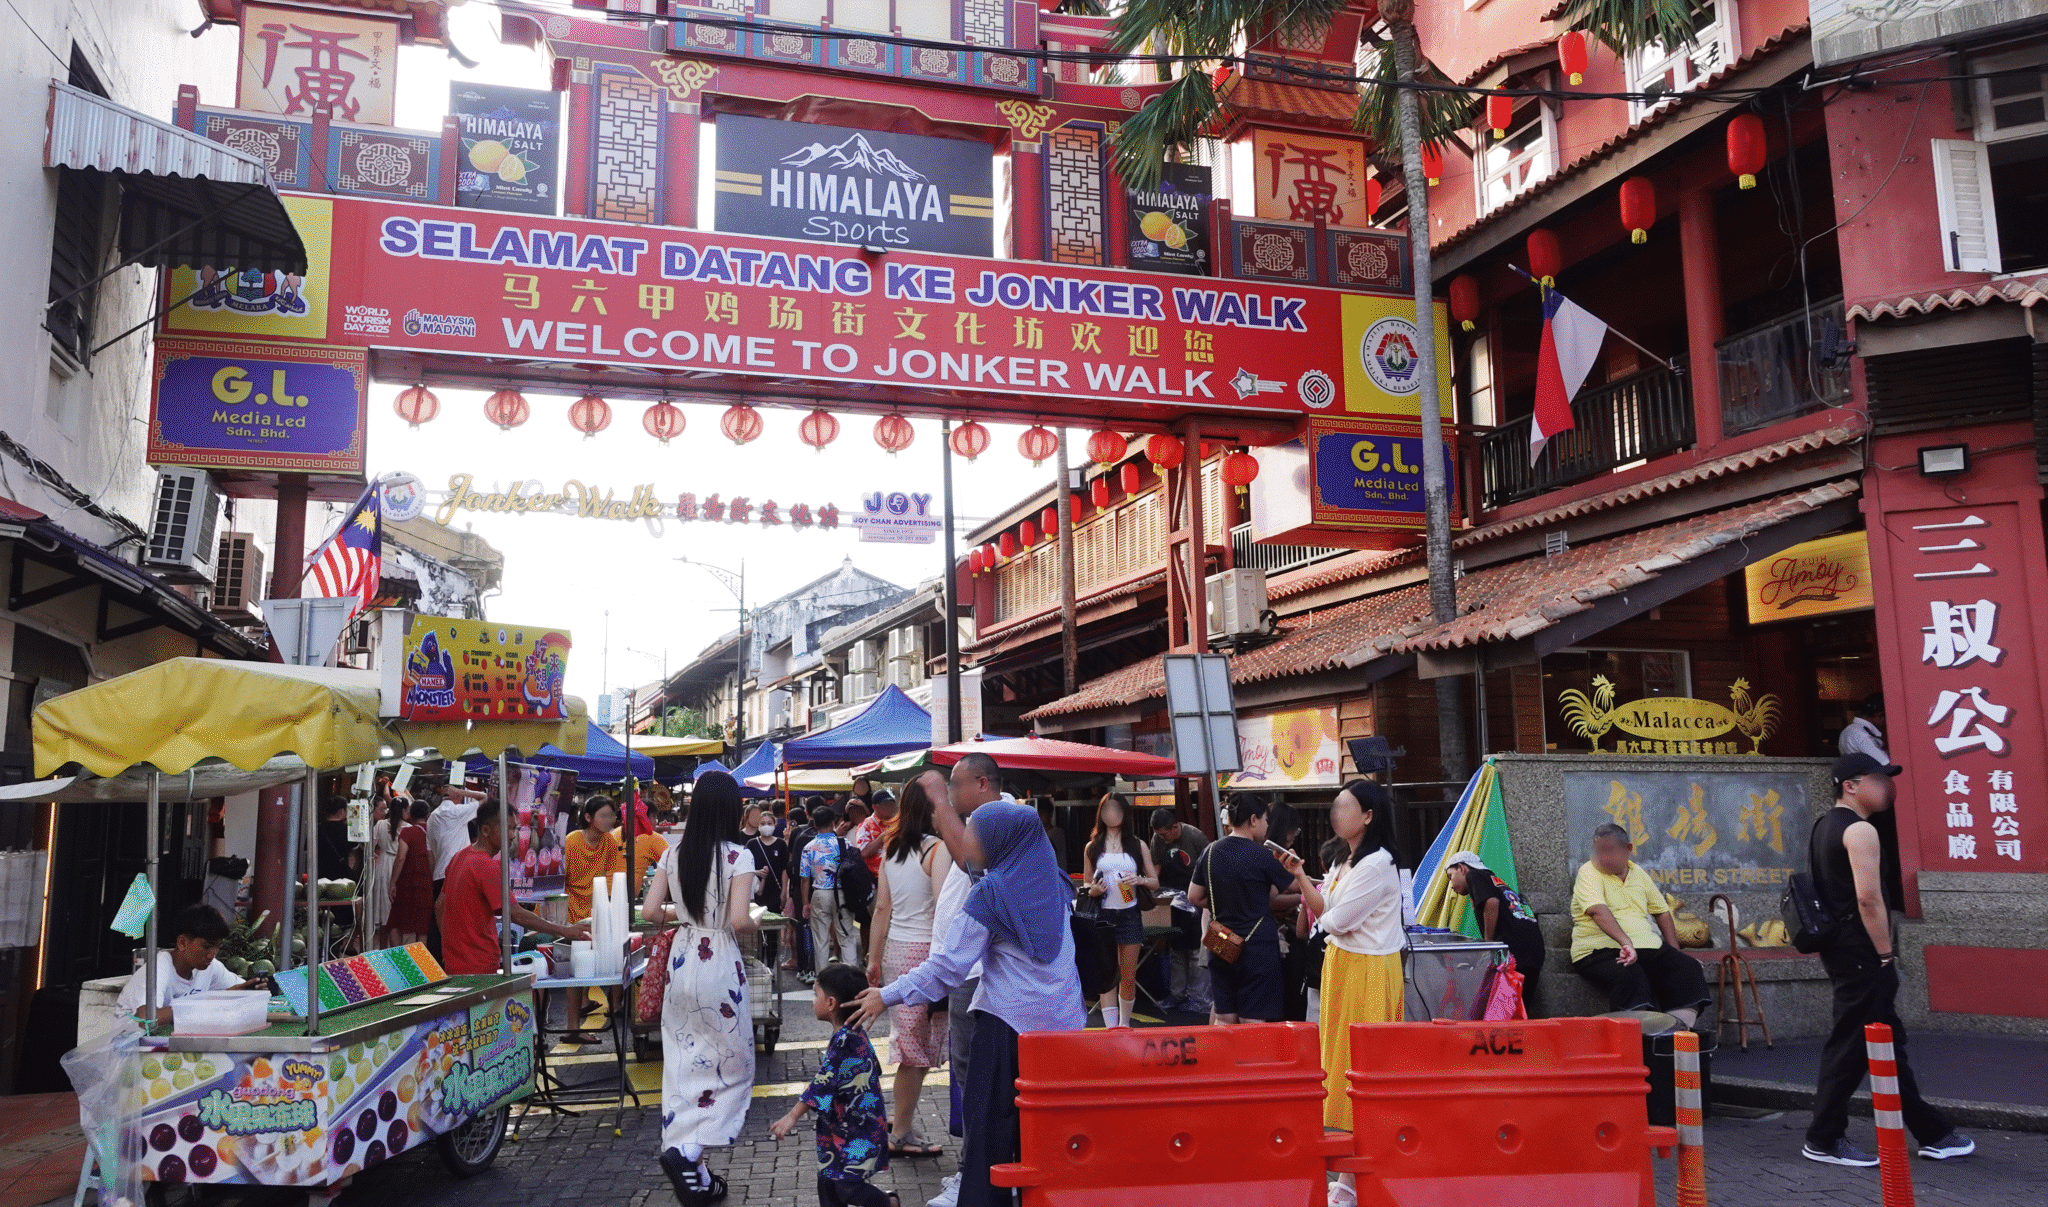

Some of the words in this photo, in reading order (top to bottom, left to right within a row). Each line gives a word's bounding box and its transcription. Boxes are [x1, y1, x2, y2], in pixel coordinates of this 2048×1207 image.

[466, 116, 543, 141] HIMALAYA
[514, 140, 543, 151] SALT
[771, 168, 944, 222] HIMALAYA
[1137, 190, 1199, 211] HIMALAYA
[1176, 211, 1199, 220] SALT
[802, 217, 910, 243] Sports
[380, 217, 648, 276] SELAMAT
[661, 242, 871, 296] DATANG
[885, 262, 954, 303] KE
[965, 272, 1166, 320] JONKER
[1173, 287, 1307, 332] WALK
[232, 302, 269, 310] MELAKA
[345, 305, 389, 316] WORLD
[343, 323, 365, 332] DAY
[366, 325, 389, 333] 2025
[345, 314, 391, 325] TOURISM
[423, 314, 475, 325] MALAYSIA
[503, 273, 1215, 363] 马六甲鸡场街文化坊欢迎您
[423, 323, 475, 336] MADANI
[502, 318, 776, 367] WELCOME
[792, 340, 858, 372] TO
[873, 347, 1070, 388] JONKER
[1083, 361, 1215, 398] WALK
[211, 366, 309, 408] G.L.
[212, 410, 271, 425] Media
[276, 415, 306, 428] Led
[226, 426, 255, 437] Sdn.
[260, 428, 290, 439] Bhd.
[1351, 440, 1419, 474] G.L.
[1354, 476, 1395, 490] Media
[1398, 480, 1419, 491] Led
[435, 473, 570, 526] Jonker
[563, 479, 664, 520] Walk
[864, 491, 931, 516] JOY
[1364, 491, 1386, 499] Sdn.
[1388, 492, 1410, 500] Bhd.
[893, 519, 942, 527] ADVERTISING
[1761, 557, 1859, 605] Amoy
[1912, 515, 2008, 753] 三叔公
[1632, 710, 1716, 729] Malacca
[1943, 770, 1978, 860] 食品廠
[1987, 770, 2021, 861] 有限公司
[1648, 868, 1708, 885] NKER
[1713, 867, 1796, 885] STREET
[1140, 1037, 1198, 1067] ACE
[1469, 1028, 1524, 1056] ACE
[233, 1087, 295, 1099] guodong
